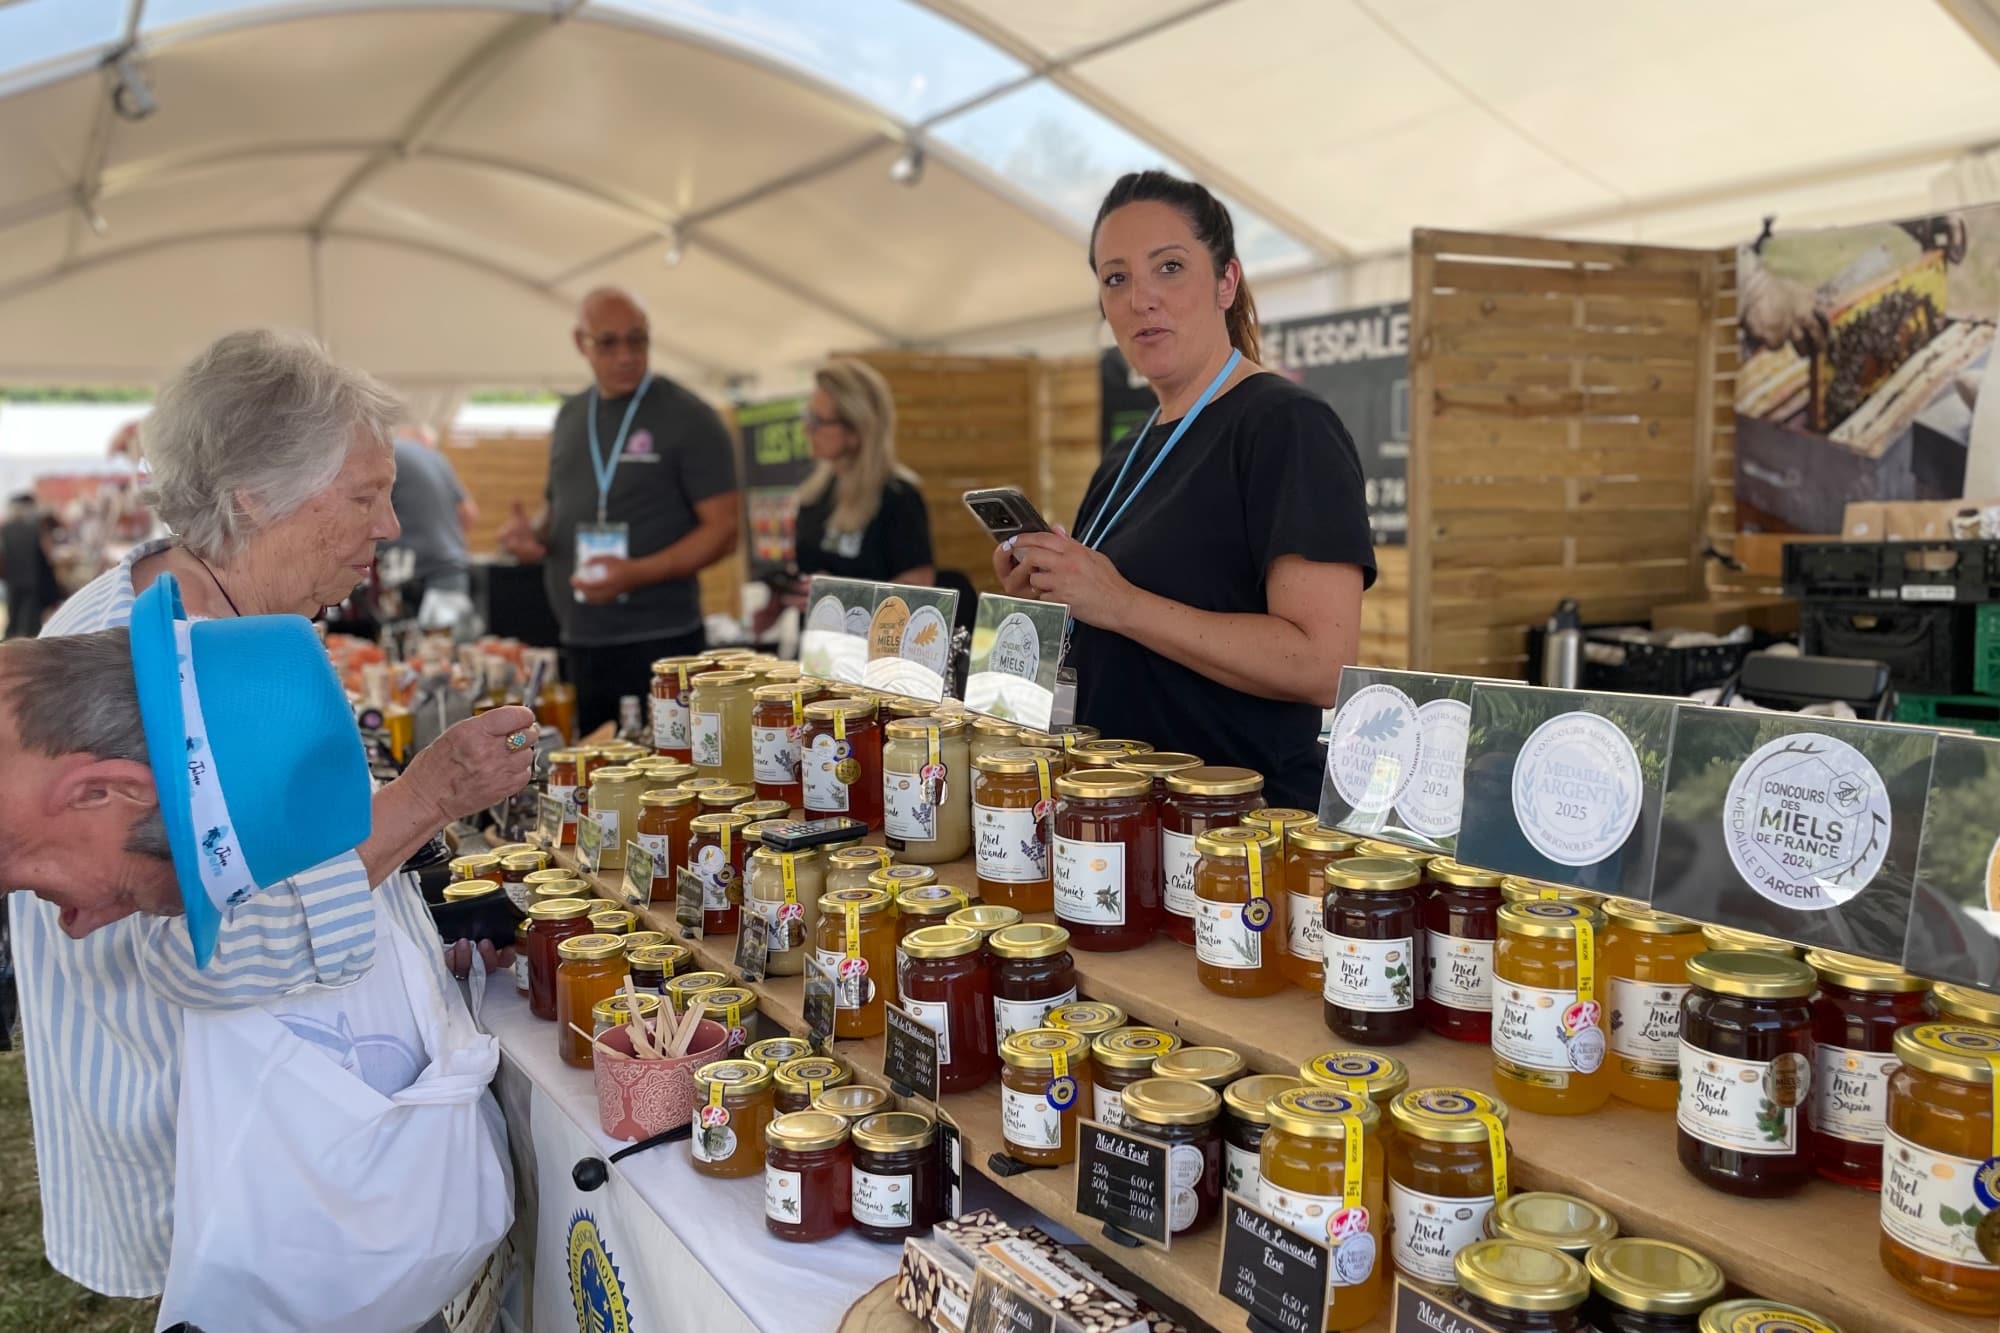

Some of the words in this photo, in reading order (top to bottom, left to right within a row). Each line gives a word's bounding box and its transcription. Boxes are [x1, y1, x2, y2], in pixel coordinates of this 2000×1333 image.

[1285, 313, 1410, 369] L'ESCALE
[878, 635, 900, 647] MIELS
[1000, 655, 1025, 673] MIELS
[1534, 726, 1586, 758] CONCOURS
[1589, 728, 1627, 771] AGRICOLE
[1420, 759, 1464, 781] RGENT
[1422, 780, 1449, 798] 2024
[1537, 777, 1612, 805] ARGENT
[1764, 780, 1825, 804] CONCOURS
[1555, 801, 1588, 821] 2025
[1780, 799, 1801, 811] DES
[1759, 806, 1844, 843] MIELS
[982, 831, 1001, 845] Miel
[1539, 828, 1595, 852] BRIGNOLES
[1756, 832, 1771, 844] DE
[1774, 833, 1840, 859] FRANCE
[978, 841, 1008, 861] Lavande
[1782, 852, 1813, 870] 2024
[1754, 866, 1821, 899] D'ARGENT
[1310, 916, 1323, 930] Mi
[1302, 928, 1323, 943] Roma
[1341, 960, 1364, 977] Miel
[1452, 961, 1478, 977] Miel
[1504, 1005, 1528, 1026] Miel
[1650, 1007, 1680, 1026] Miel
[1499, 1020, 1534, 1041] Lavande
[1638, 1022, 1680, 1042] Lavand
[1696, 1076, 1728, 1100] Miel
[1833, 1074, 1869, 1098] Miel
[1695, 1094, 1730, 1117] Sapin
[1832, 1092, 1872, 1114] Sapin
[1096, 1132, 1114, 1151] Miel
[1115, 1138, 1127, 1155] de
[1128, 1143, 1149, 1164] Forêt
[1092, 1162, 1109, 1178] 250g
[1148, 1181, 1155, 1193] €
[1890, 1162, 1919, 1197] Miel
[1091, 1176, 1109, 1194] 500g
[1150, 1196, 1156, 1208] €
[1149, 1212, 1155, 1224] €
[1414, 1218, 1444, 1241] Miel
[1236, 1207, 1259, 1231] Miel
[1259, 1222, 1271, 1239] de
[1271, 1228, 1318, 1266] Lavande
[1406, 1234, 1451, 1257] Lavande
[1263, 1246, 1284, 1271] Fine
[1238, 1265, 1257, 1289] 250g
[1302, 1304, 1309, 1317] €
[1235, 1281, 1255, 1305] 500g
[1301, 1322, 1309, 1333] €
[1417, 1301, 1446, 1332] Miel
